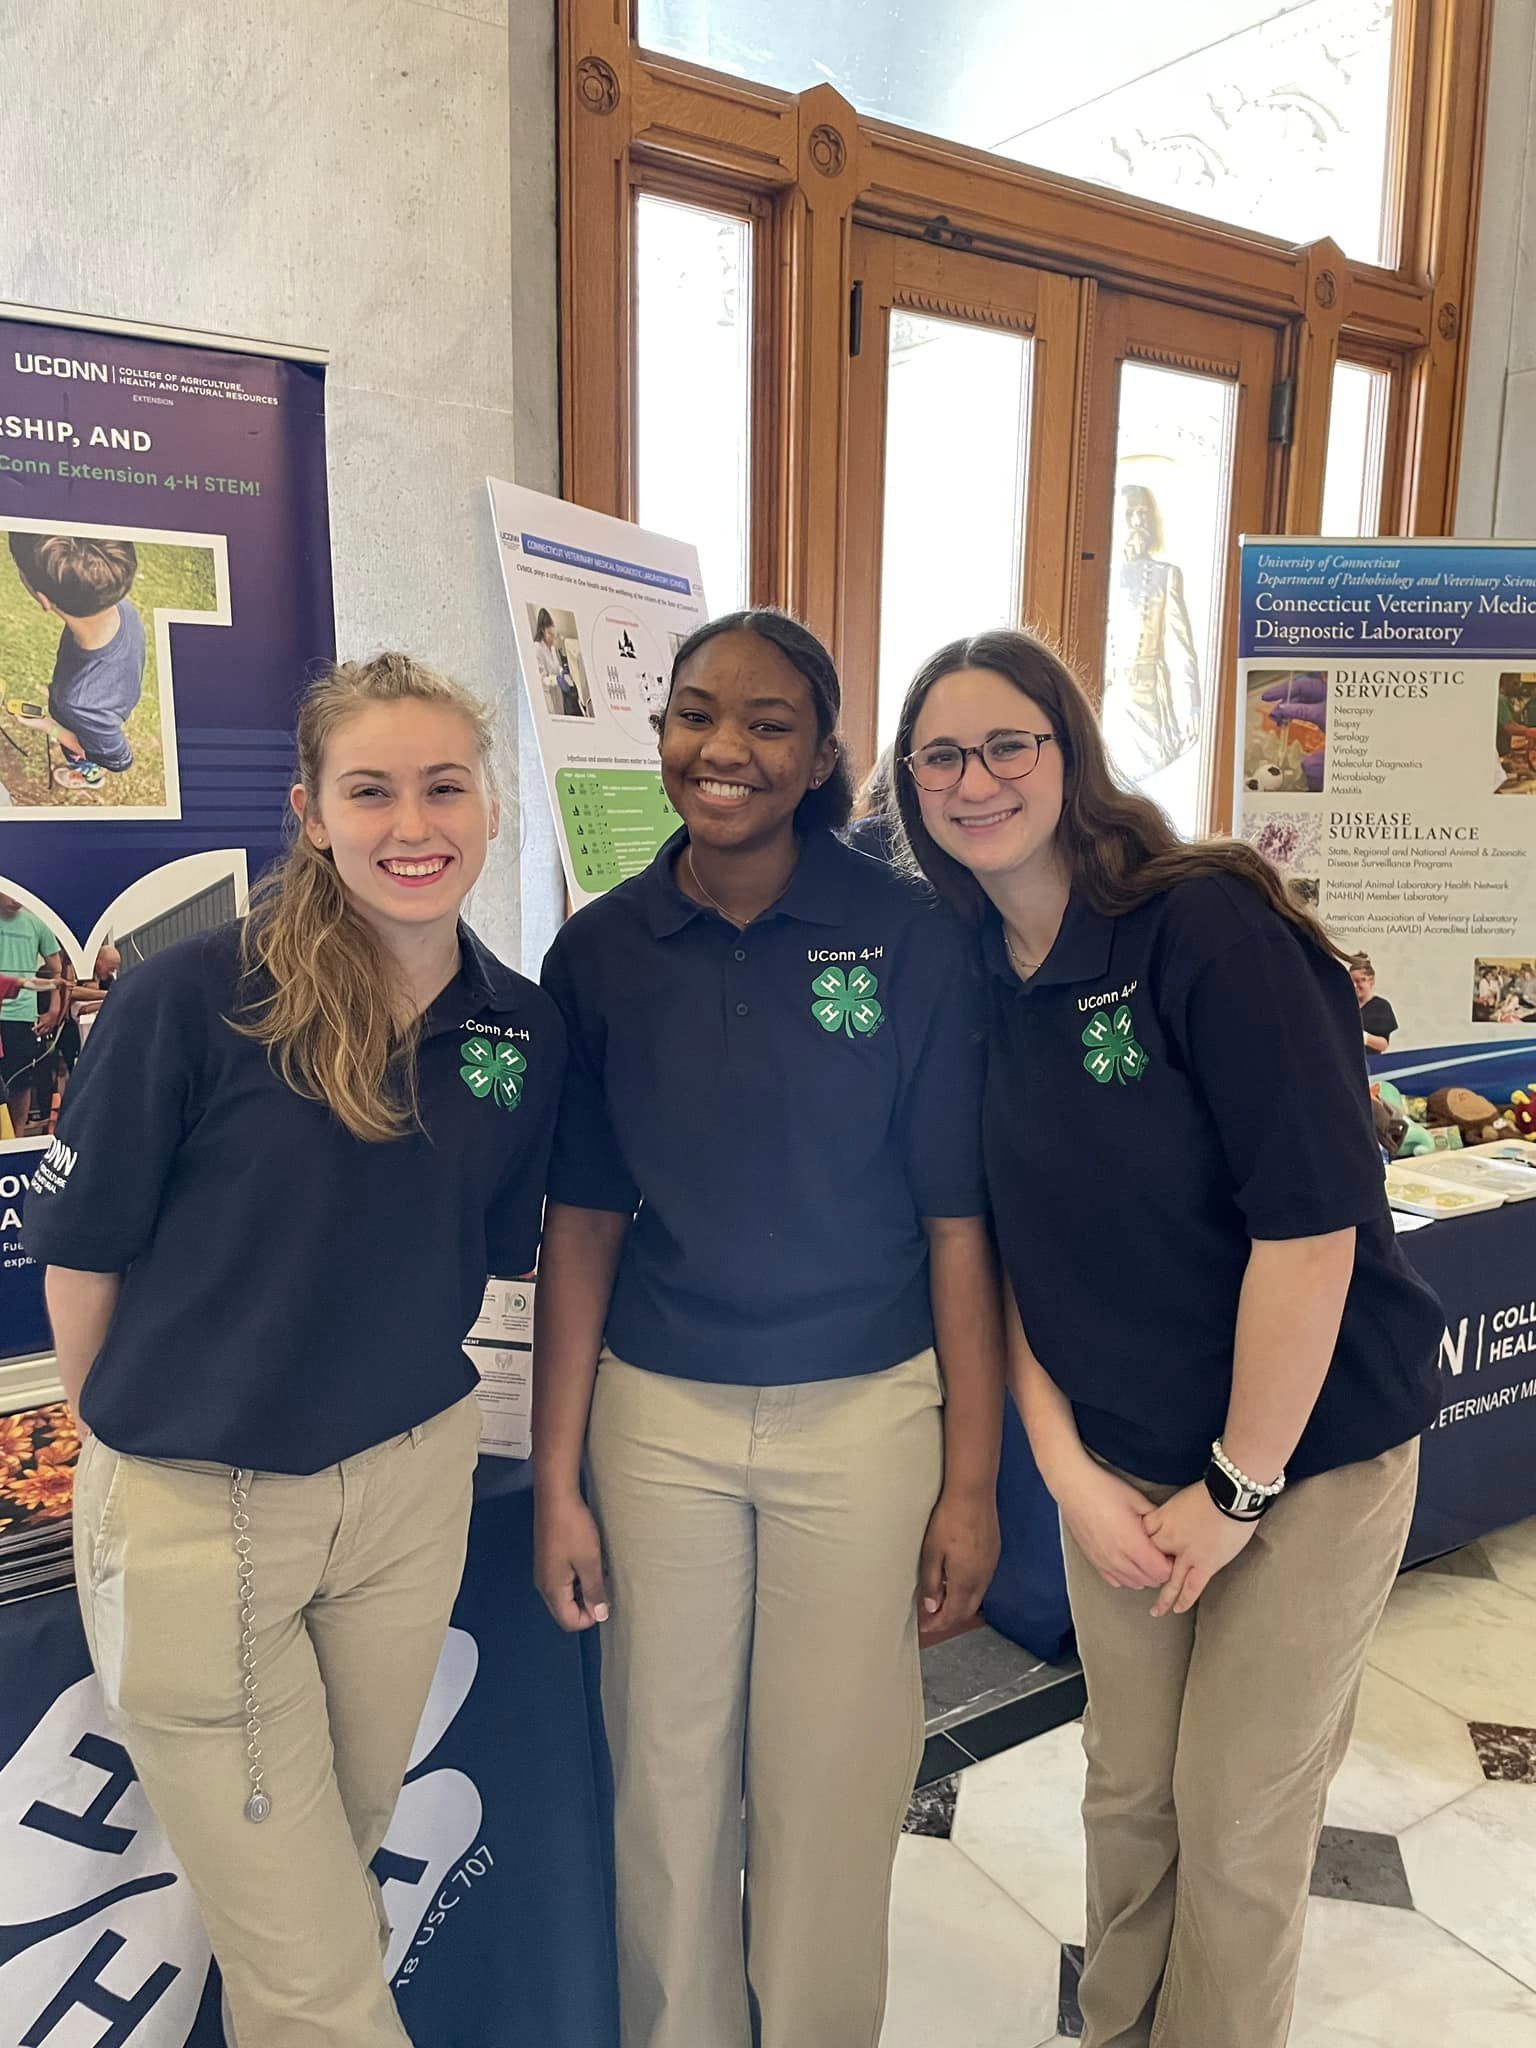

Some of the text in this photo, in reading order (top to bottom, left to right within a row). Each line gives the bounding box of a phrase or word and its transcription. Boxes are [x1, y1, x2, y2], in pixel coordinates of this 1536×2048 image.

[15, 352, 107, 383] UCONN
[119, 368, 244, 393] COLLEGE OF AGRICULTURE,
[119, 376, 278, 406] HEALTH AND NATURAL RESOURCES
[133, 394, 174, 406] EXTENSION
[89, 426, 151, 452] AND
[58, 461, 158, 486] Extension
[164, 475, 198, 491] 4-H
[205, 477, 260, 497] STEM!
[1258, 554, 1400, 572] University of Connecticut
[1256, 572, 1324, 588] Department
[1328, 572, 1342, 588] of
[1342, 573, 1414, 590] Pathobiology
[1417, 574, 1440, 587] and
[1443, 575, 1500, 590] Veterinary
[1256, 592, 1370, 613] Connecticut
[1377, 594, 1472, 620] Veterinary
[1256, 620, 1464, 646] Diagnostic Laboratory
[1336, 670, 1464, 686] DIAGNOSTIC
[1334, 684, 1429, 698] SERVICES
[1334, 706, 1374, 717] Necropsy
[1333, 719, 1360, 730] Biopsy
[1333, 732, 1370, 744] Serology
[1332, 746, 1368, 757] Virology
[1332, 759, 1423, 771] Molecular Diagnostics
[1331, 773, 1386, 784] Microbiology
[1331, 786, 1362, 794] Mastitis
[1330, 812, 1412, 826] DISEASE
[1328, 827, 1480, 840] SURVEILLANCE
[1328, 847, 1526, 859] State, Regional and National Animal & Zoonotic
[1328, 859, 1452, 870] Disease Surveillance Programs
[1326, 880, 1508, 891] National Animal Laboratory Health Network
[1326, 891, 1448, 902] (NAHLN) Member Laboratory
[1326, 913, 1518, 924] American Association of Veterinary Laboratory
[1386, 925, 1422, 935] (AAVLD)
[1424, 925, 1469, 935] Accredited
[1470, 926, 1516, 936] Laboratory
[808, 946, 884, 962] UConn 4-H
[820, 974, 841, 993] H
[852, 973, 871, 994] H
[1078, 980, 1137, 1012] UConn 4-H
[820, 1003, 840, 1023] H
[855, 1004, 874, 1024] H
[459, 1019, 530, 1041] Conn 4-H
[1089, 1020, 1108, 1040] H
[1117, 1013, 1131, 1035] H
[468, 1042, 488, 1061] H
[500, 1049, 519, 1066] H
[1124, 1046, 1138, 1068] H
[1091, 1053, 1110, 1074] H
[468, 1069, 489, 1088] H
[502, 1077, 517, 1099] H
[396, 1844, 494, 1989] 18 USC 707
